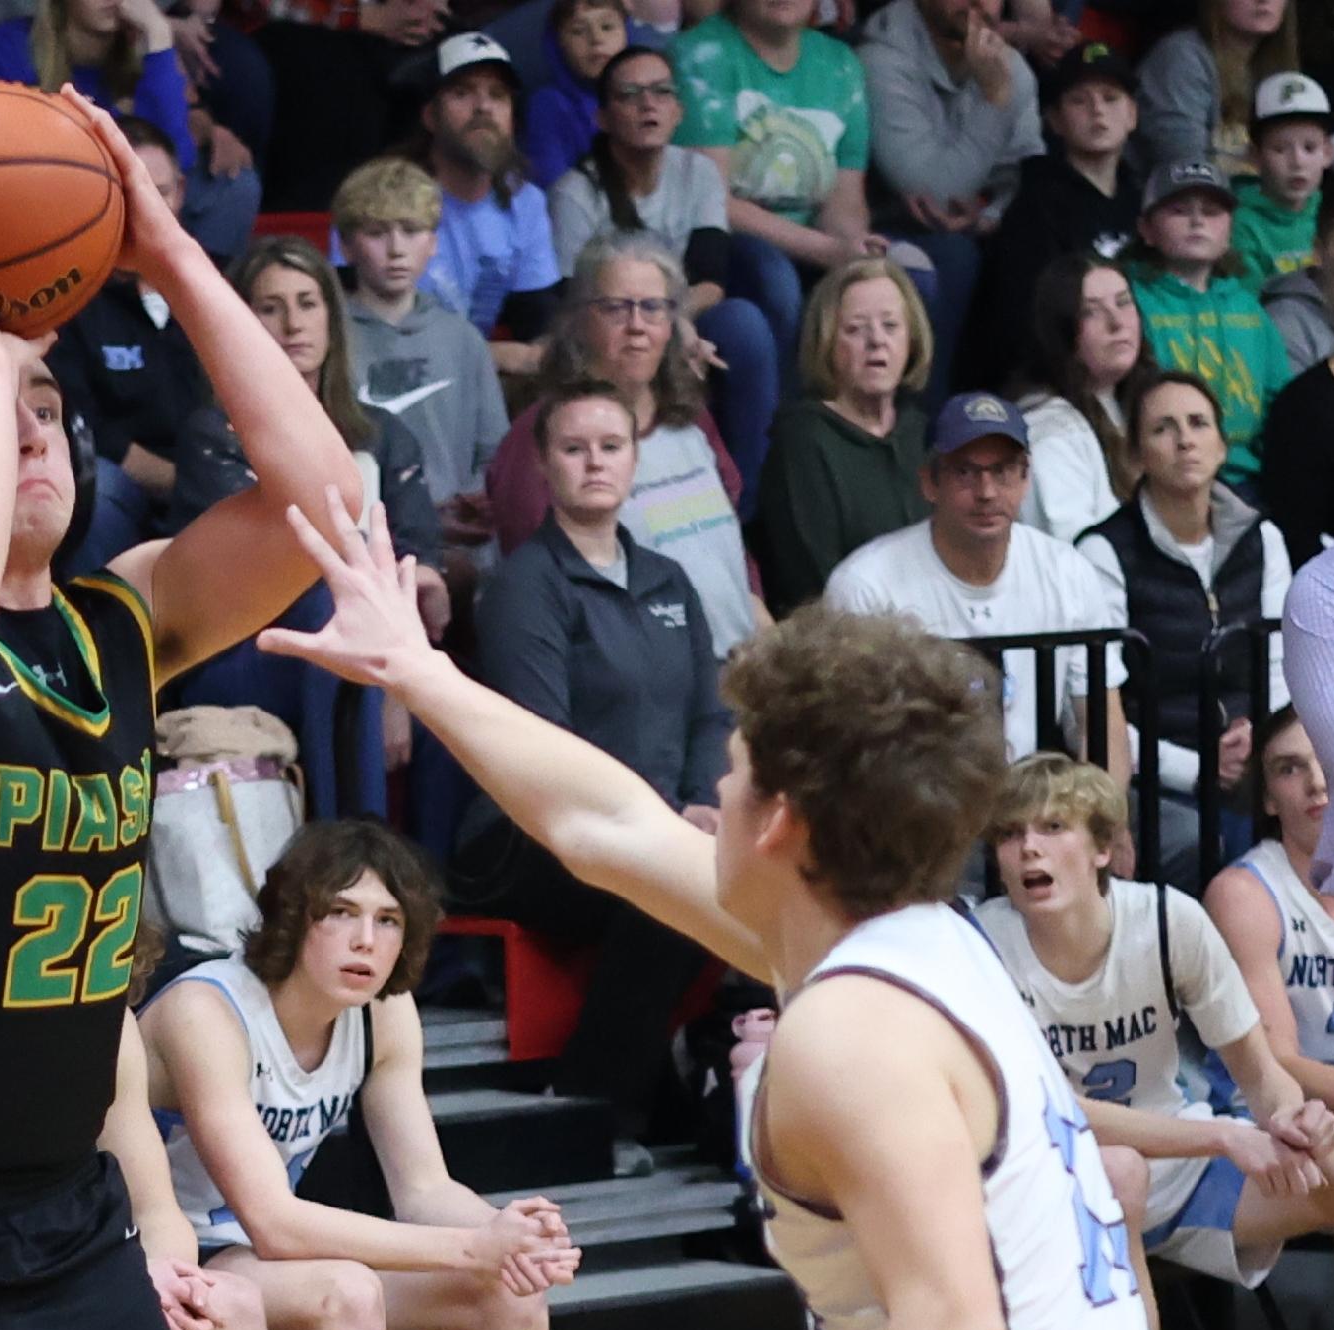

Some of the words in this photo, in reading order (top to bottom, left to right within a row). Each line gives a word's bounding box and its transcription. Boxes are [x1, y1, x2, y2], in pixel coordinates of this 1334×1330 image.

[3, 862, 142, 1009] 22
[1103, 1006, 1157, 1050] MAC
[1081, 1058, 1137, 1107] 2
